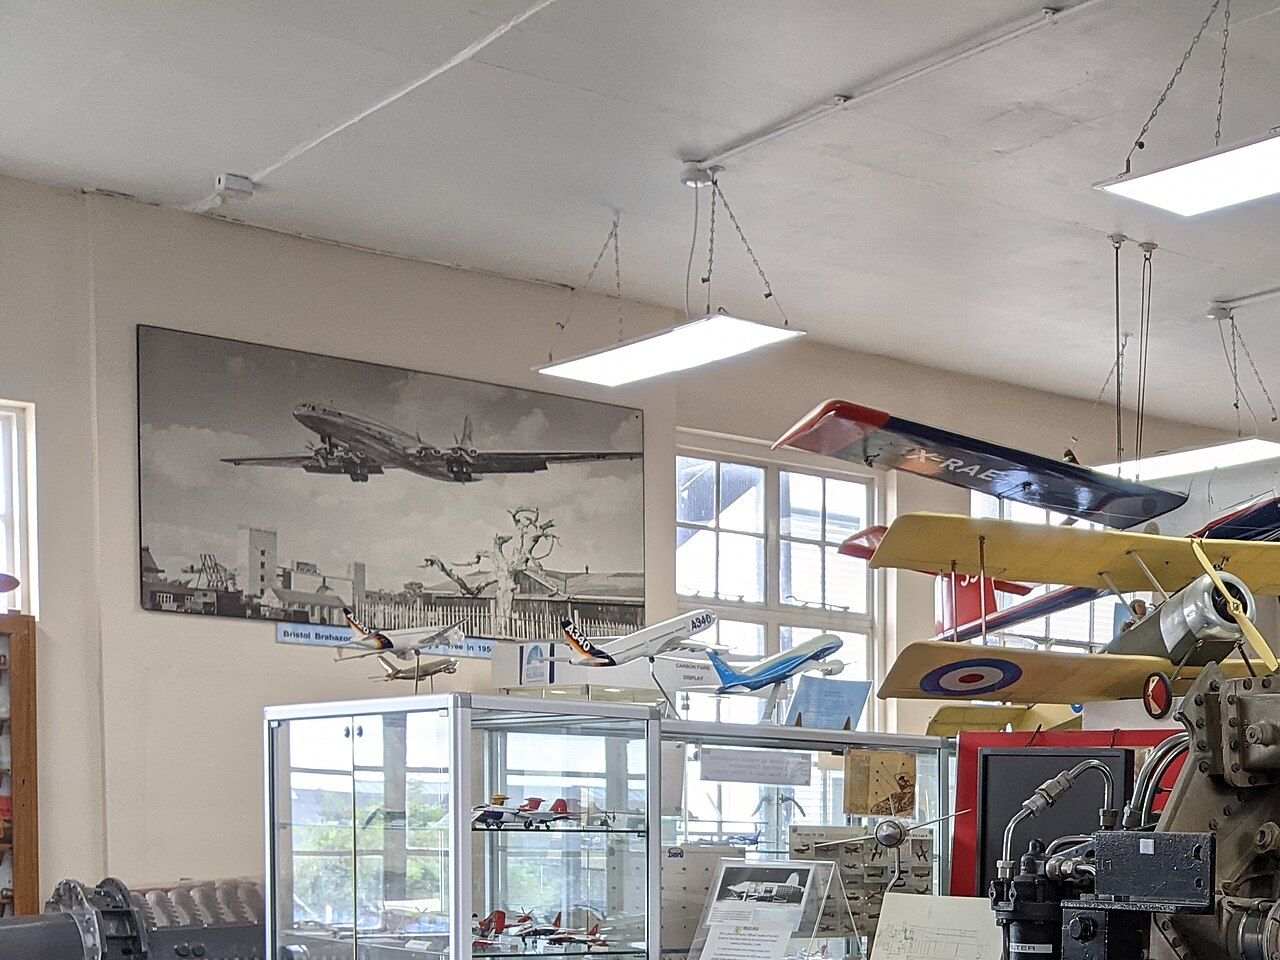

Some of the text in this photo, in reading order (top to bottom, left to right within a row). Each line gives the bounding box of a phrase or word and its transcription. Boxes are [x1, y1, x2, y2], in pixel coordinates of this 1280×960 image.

[905, 449, 1000, 481] X-RAE
[691, 614, 712, 631] A340
[283, 630, 311, 639] Bristol
[565, 624, 591, 652] A340
